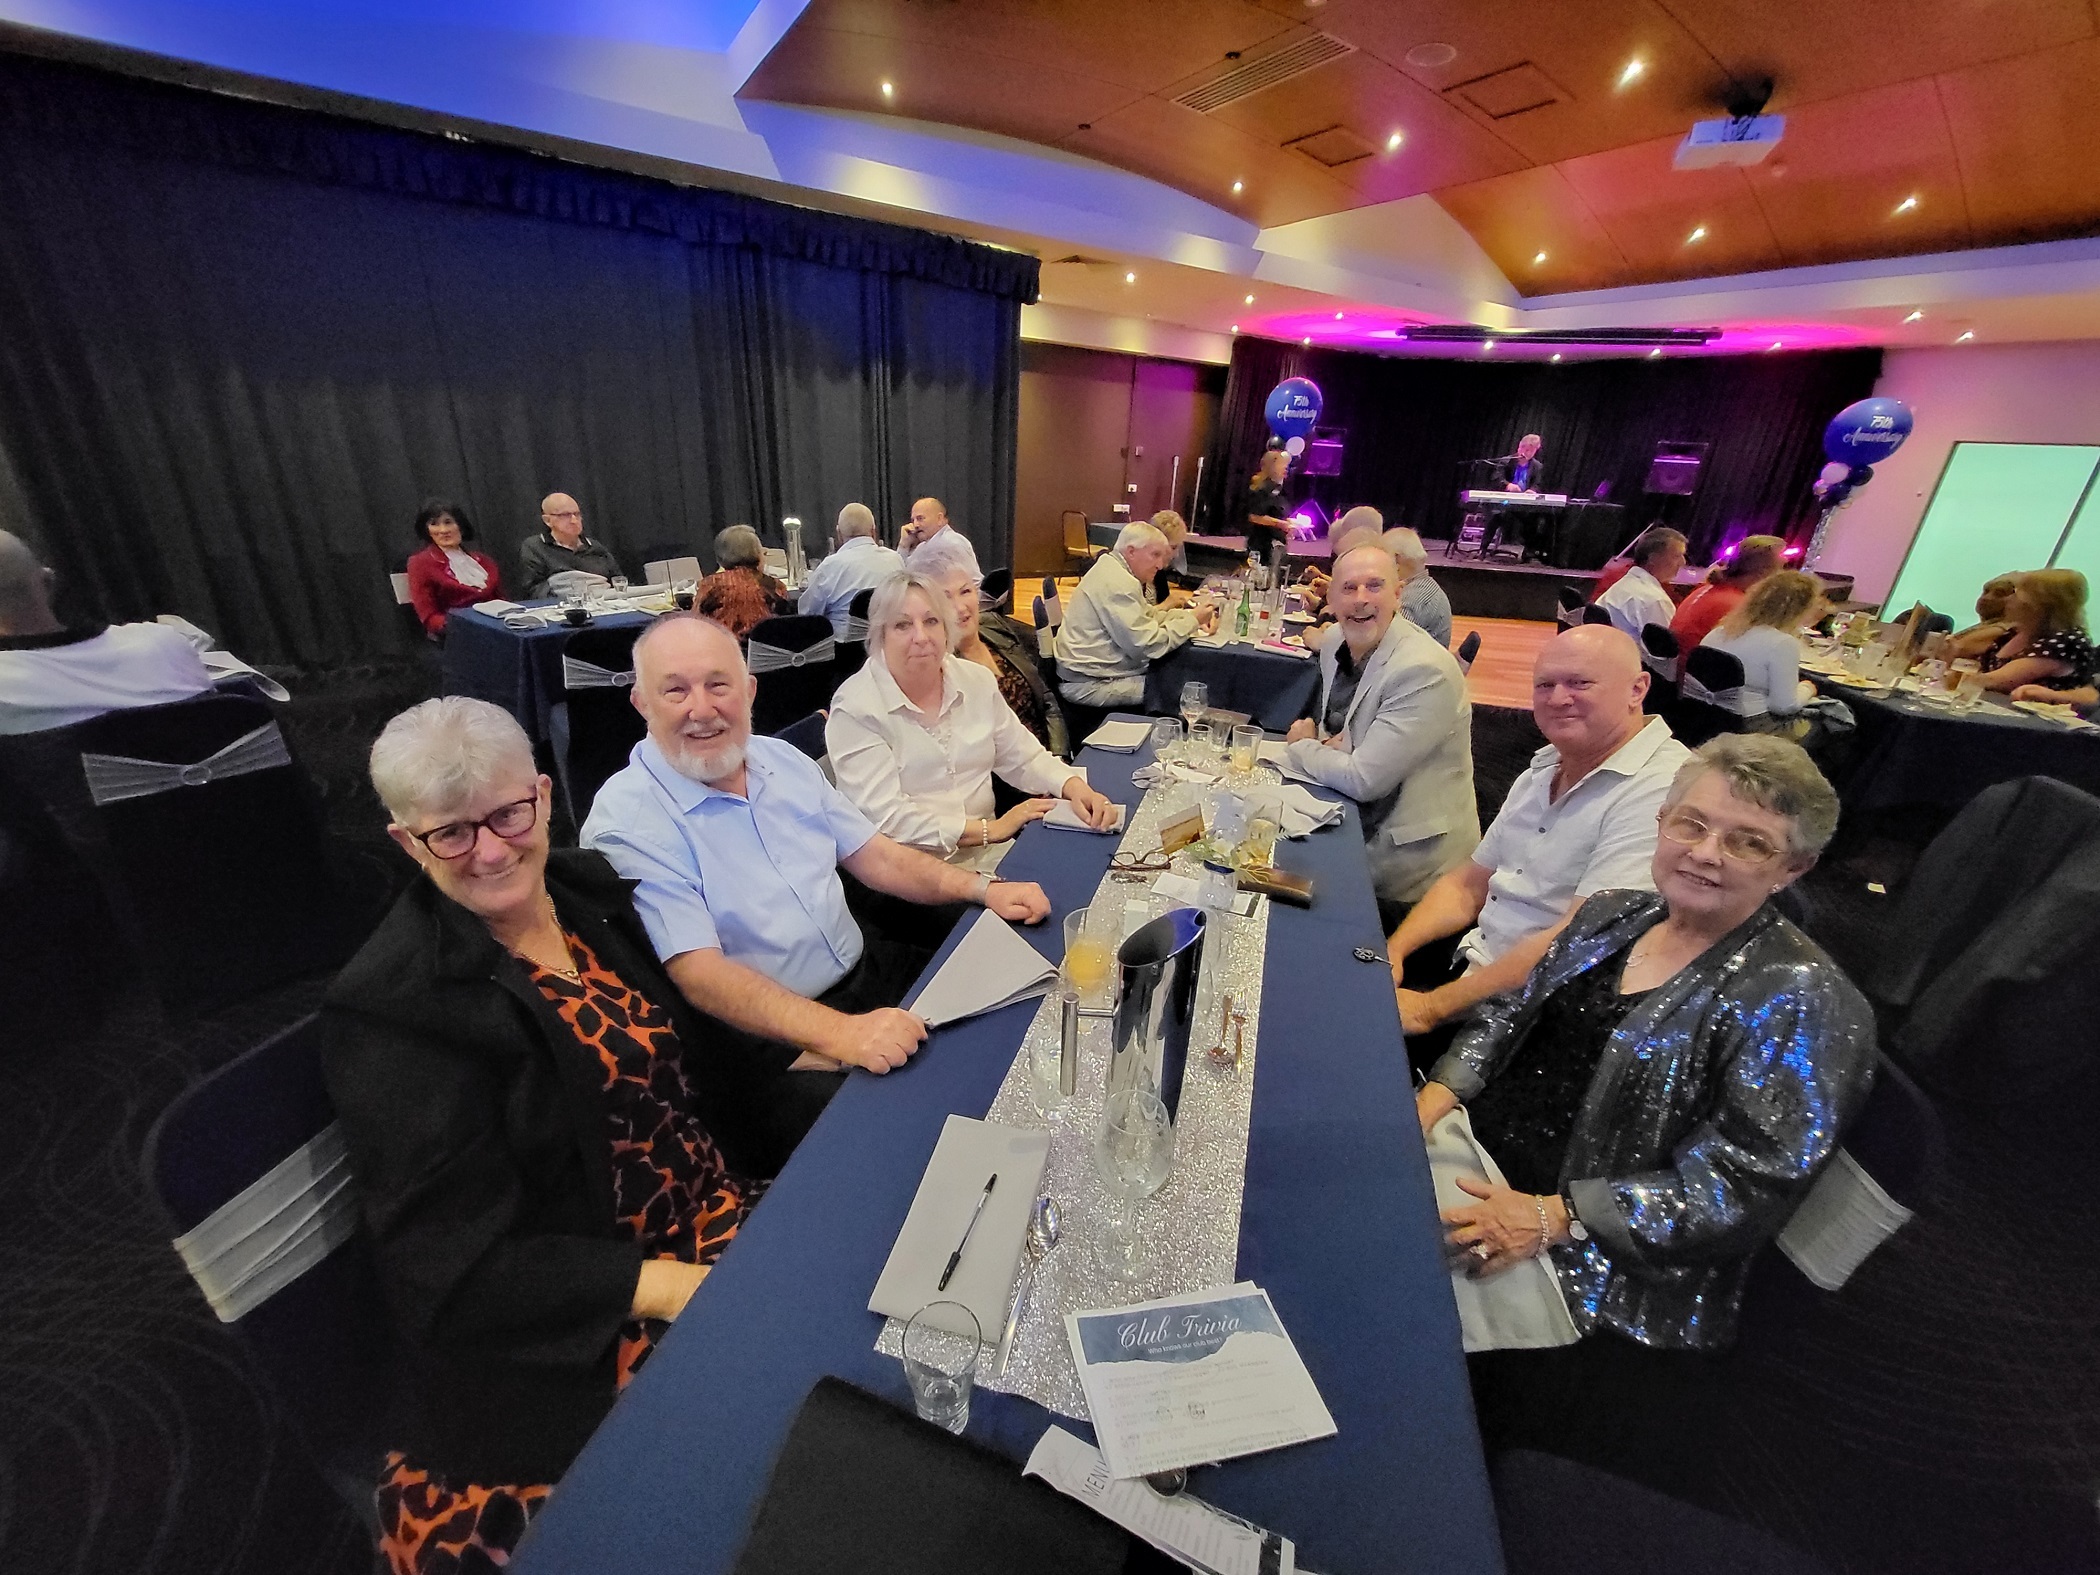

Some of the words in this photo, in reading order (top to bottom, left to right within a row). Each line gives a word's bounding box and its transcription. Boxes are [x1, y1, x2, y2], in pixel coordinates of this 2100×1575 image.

[1293, 395, 1310, 407] 75th
[1277, 404, 1317, 425] Anniversary
[1870, 415, 1894, 429] 75th
[1843, 427, 1902, 450] Anniversary
[1117, 1315, 1171, 1350] Club
[1177, 1314, 1242, 1338] Trivia
[1163, 1344, 1182, 1352] knows
